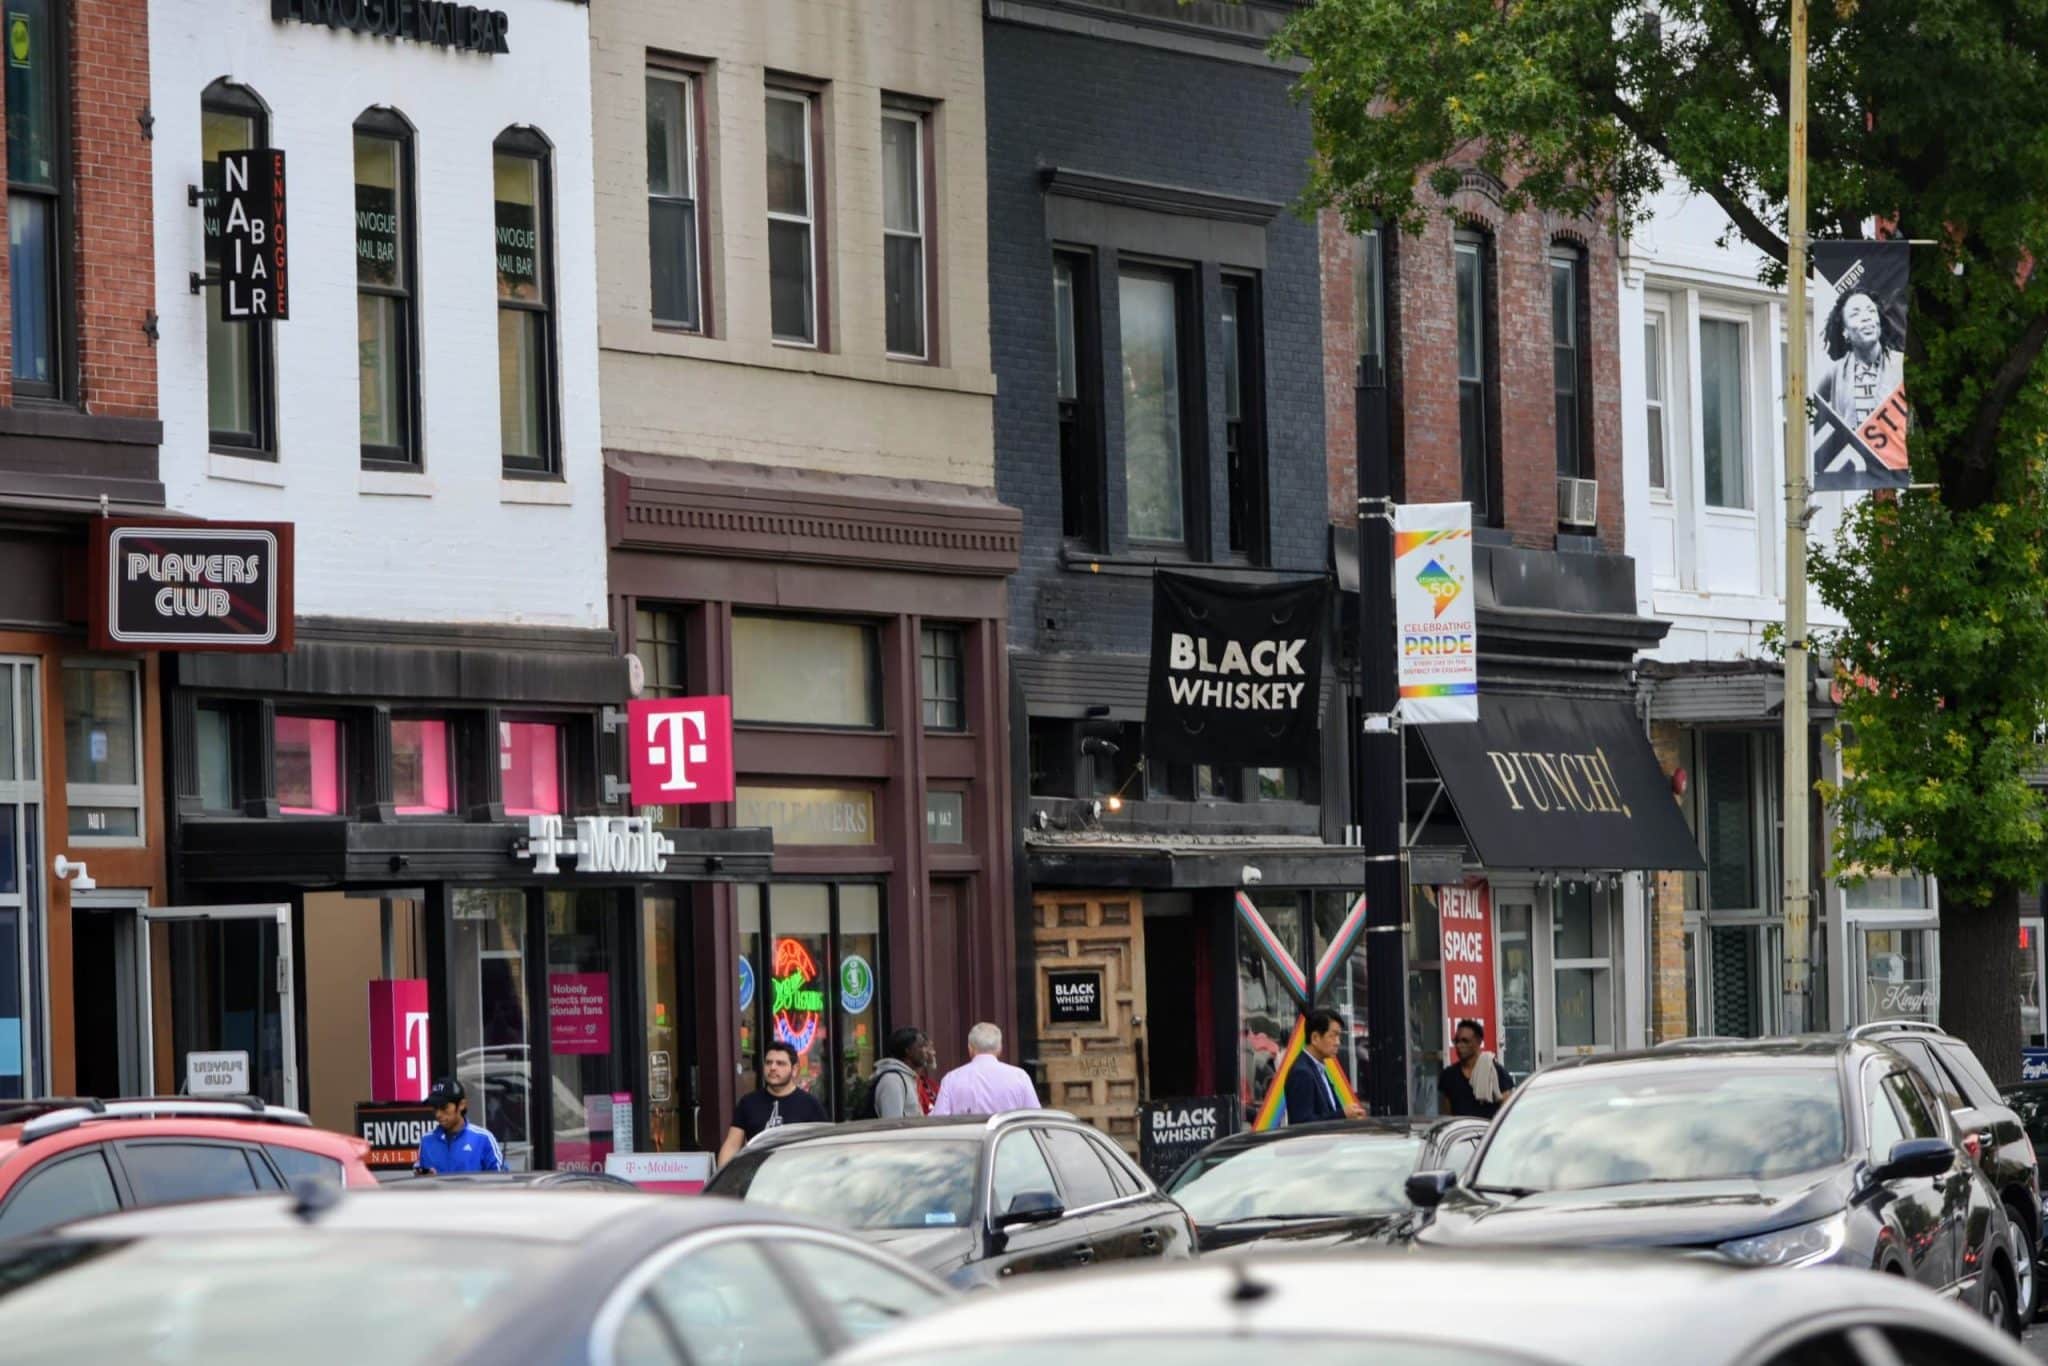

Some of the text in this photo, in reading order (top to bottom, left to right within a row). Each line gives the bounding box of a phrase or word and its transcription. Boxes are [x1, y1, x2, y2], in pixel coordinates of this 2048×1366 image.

[466, 6, 509, 54] BAR
[355, 211, 396, 234] NVOGUE
[225, 155, 268, 315] NAIL BAR
[273, 155, 285, 314] ENVOGUE
[496, 227, 535, 249] NVOGUE
[376, 241, 395, 261] BAR
[516, 257, 533, 276] BAR
[1836, 264, 1865, 294] STUDIO
[127, 553, 260, 584] PLAYERS
[1430, 582, 1456, 597] 50
[155, 587, 231, 617] CLUB
[1404, 621, 1472, 633] CELEBRATING
[1169, 632, 1307, 677] BLACK
[1404, 635, 1473, 656] PRIDE
[1168, 676, 1305, 710] WHISKEY
[1486, 746, 1632, 819] PUNCH!
[1442, 887, 1484, 920] RETAIL
[1444, 930, 1484, 963] SPACE
[553, 984, 588, 995] Nobody
[580, 996, 604, 1004] more
[1055, 983, 1095, 996] BLACK
[1055, 995, 1095, 1005] WHISKEY
[1453, 974, 1478, 1006] FOR
[582, 1006, 604, 1015] fans
[1152, 1107, 1217, 1129] BLACK
[363, 1120, 439, 1146] ENVOGU
[1152, 1126, 1216, 1144] WHISKEY
[371, 1152, 405, 1163] NAIL
